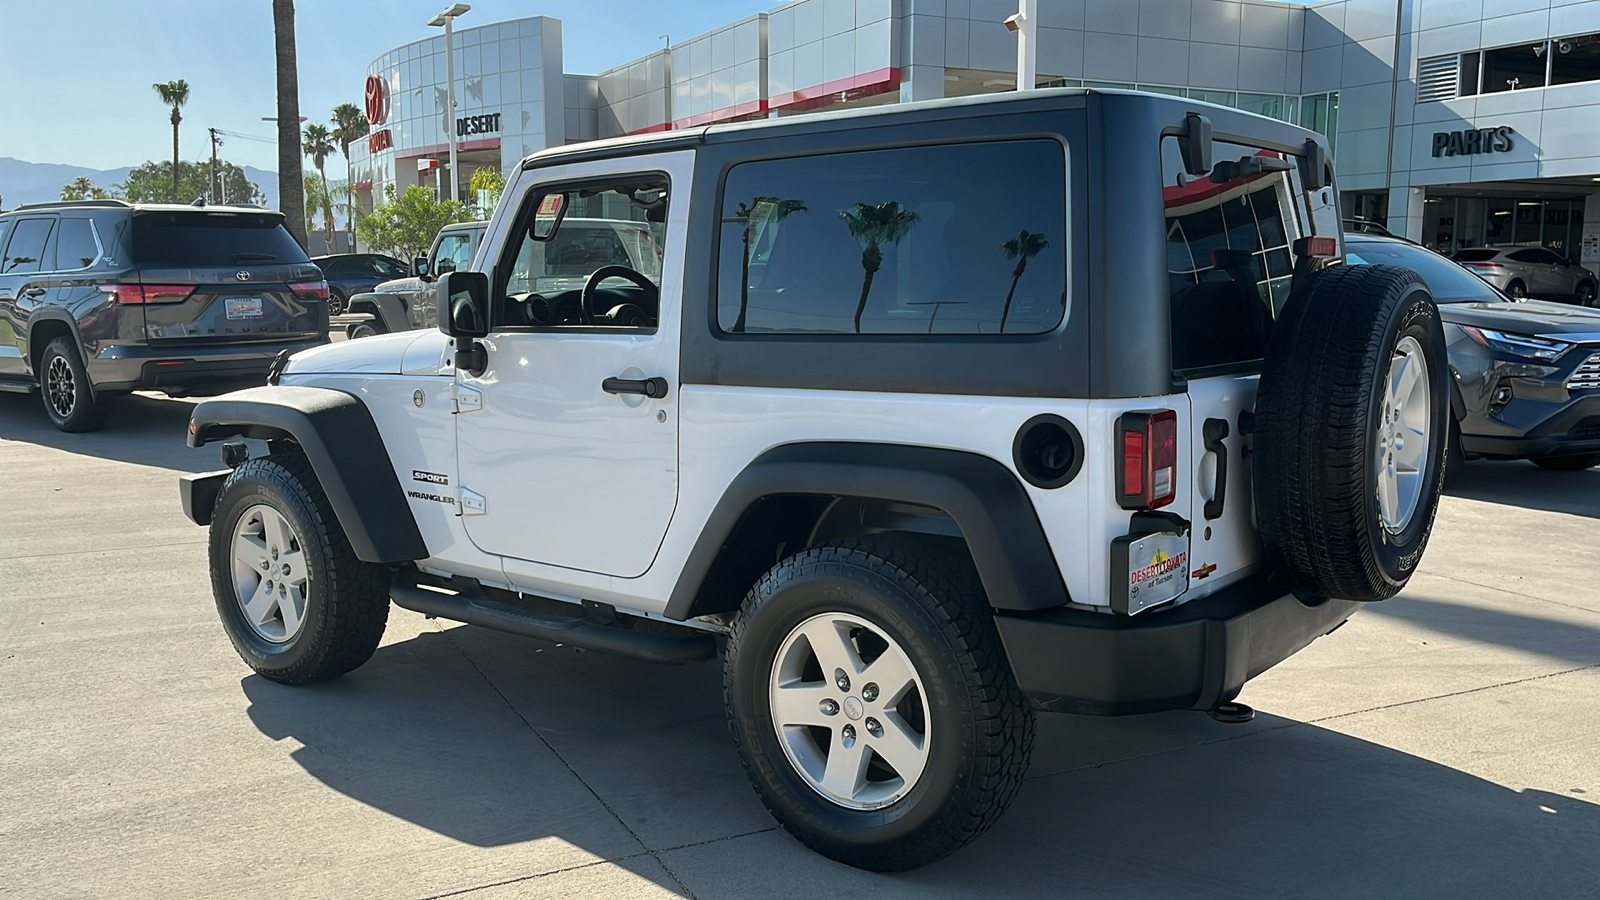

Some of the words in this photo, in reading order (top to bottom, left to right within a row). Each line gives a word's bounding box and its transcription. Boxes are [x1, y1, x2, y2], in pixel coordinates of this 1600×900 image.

[456, 112, 501, 136] DESERT
[1432, 126, 1514, 157] PARTS
[413, 471, 447, 484] SPORT
[407, 491, 455, 505] WRANGLER
[1131, 563, 1160, 585] DESERT
[1161, 551, 1187, 572] TOYOTA
[1148, 580, 1155, 588] of
[1155, 574, 1173, 586] Tucson
